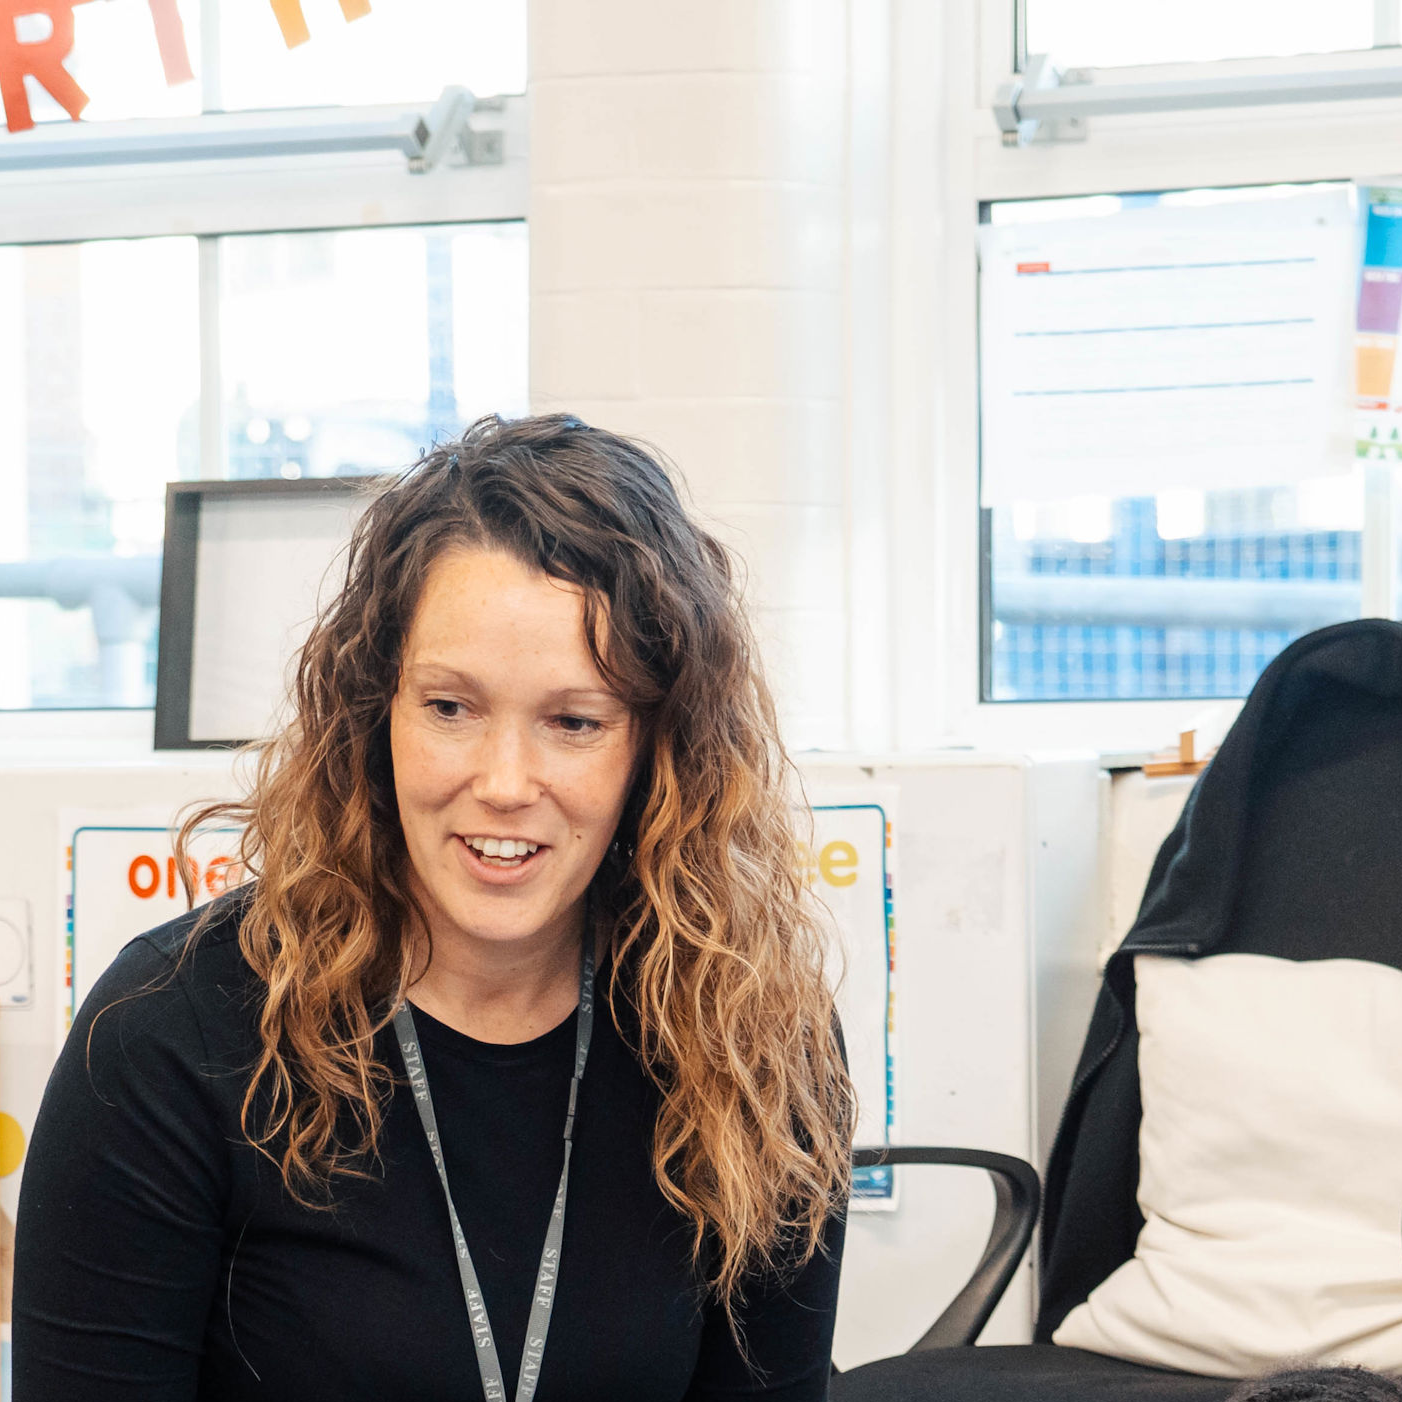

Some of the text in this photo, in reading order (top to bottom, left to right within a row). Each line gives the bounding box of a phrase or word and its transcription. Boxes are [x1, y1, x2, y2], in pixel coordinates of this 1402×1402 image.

[401, 1041, 429, 1102] STAFF
[536, 1247, 558, 1309] STAFF
[466, 1288, 492, 1348] STAFF
[521, 1336, 544, 1397] STAFF
